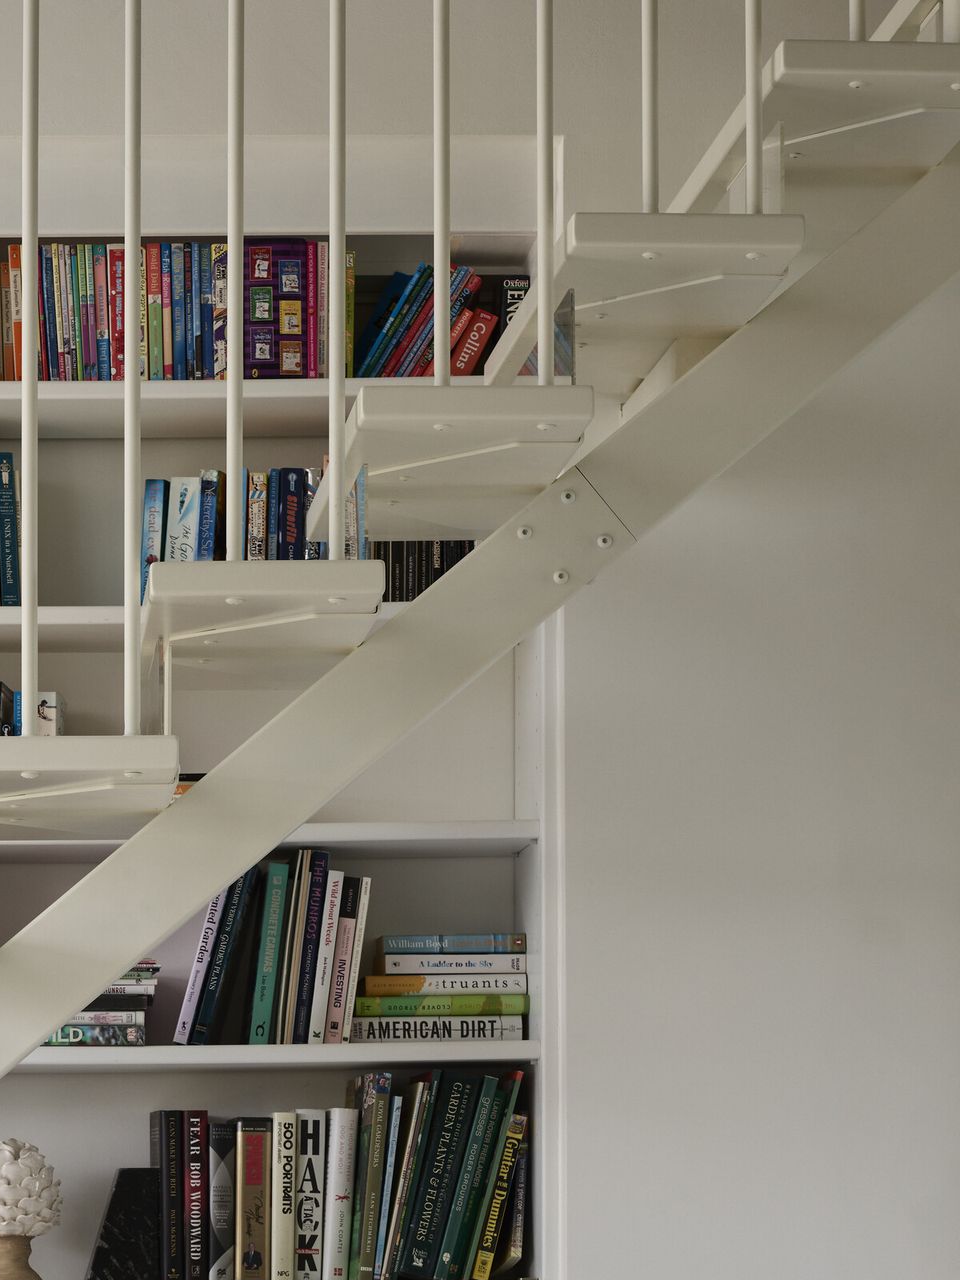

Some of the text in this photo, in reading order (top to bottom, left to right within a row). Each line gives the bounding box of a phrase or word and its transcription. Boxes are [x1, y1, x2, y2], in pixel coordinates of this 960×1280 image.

[503, 279, 528, 287] Oxford
[451, 311, 470, 337] POCKETS
[456, 322, 487, 369] Collins
[148, 507, 160, 533] dead
[307, 860, 325, 939] THE MUNROS
[197, 926, 213, 963] Garden
[389, 939, 448, 948] William Boyd
[334, 959, 346, 1008] INVESTING
[443, 979, 508, 988] truants
[367, 1021, 496, 1039] AMERICAN DIRT
[282, 1122, 293, 1215] 500 PORTRAITS
[417, 1082, 463, 1241] GARDEN PLANTS FLOWERS
[455, 1097, 491, 1211] grasses GROUNDS
[190, 1118, 201, 1260] FEAR BOB WOODWARD
[483, 1138, 520, 1249] Guitar Dummies
